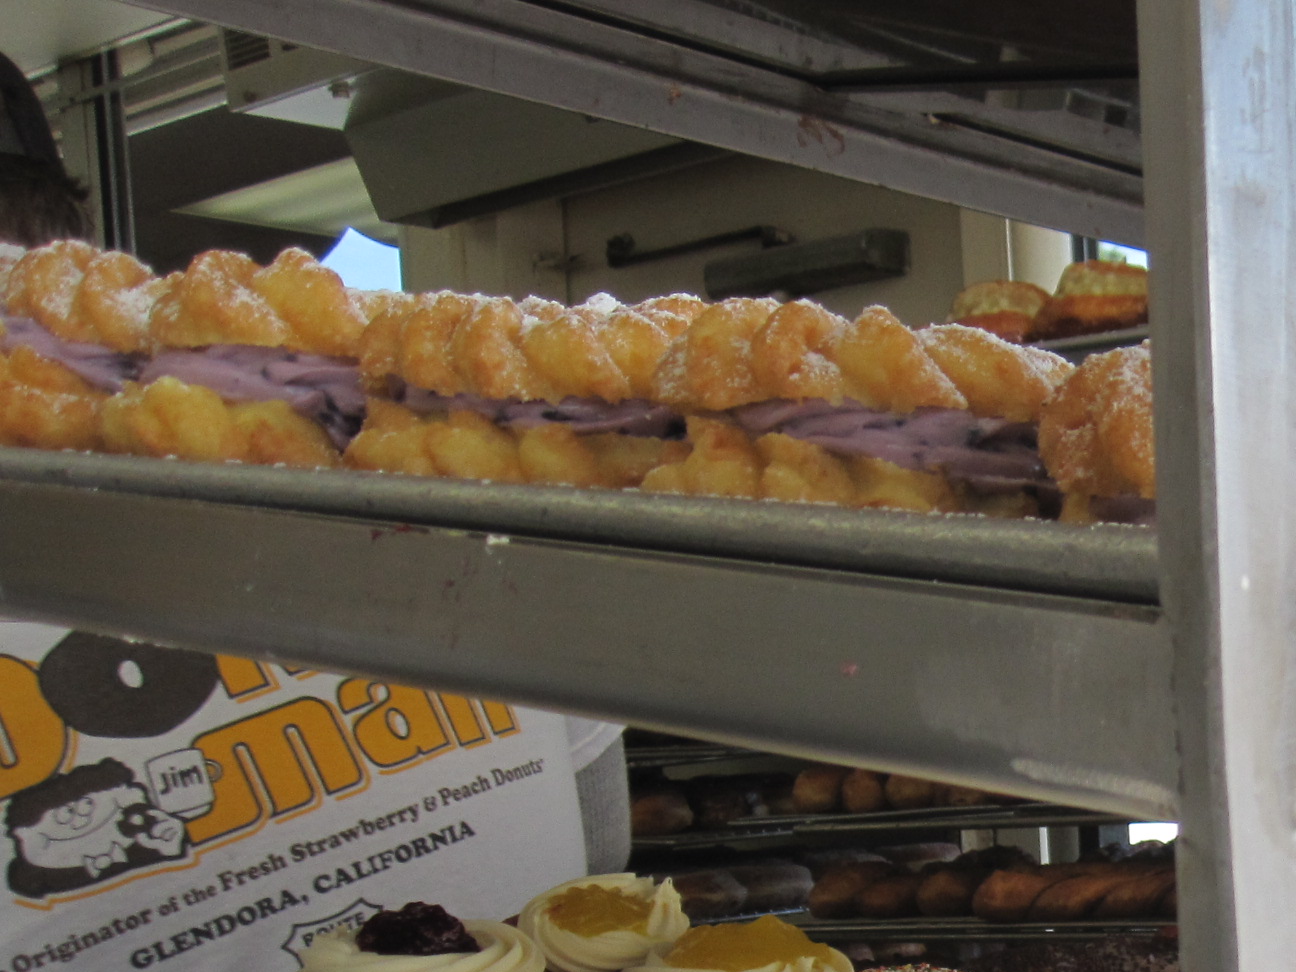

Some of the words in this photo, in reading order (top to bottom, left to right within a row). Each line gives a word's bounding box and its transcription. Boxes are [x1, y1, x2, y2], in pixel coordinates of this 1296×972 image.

[160, 765, 204, 795] Jim
[158, 896, 179, 916] of
[183, 885, 217, 906] the
[217, 853, 288, 891] Fresh
[289, 803, 419, 862] Strawberry
[438, 775, 492, 806] Peach
[131, 889, 309, 968] GLENDORA,
[313, 821, 476, 893] CALIFORNIA
[302, 911, 365, 947] RTE
